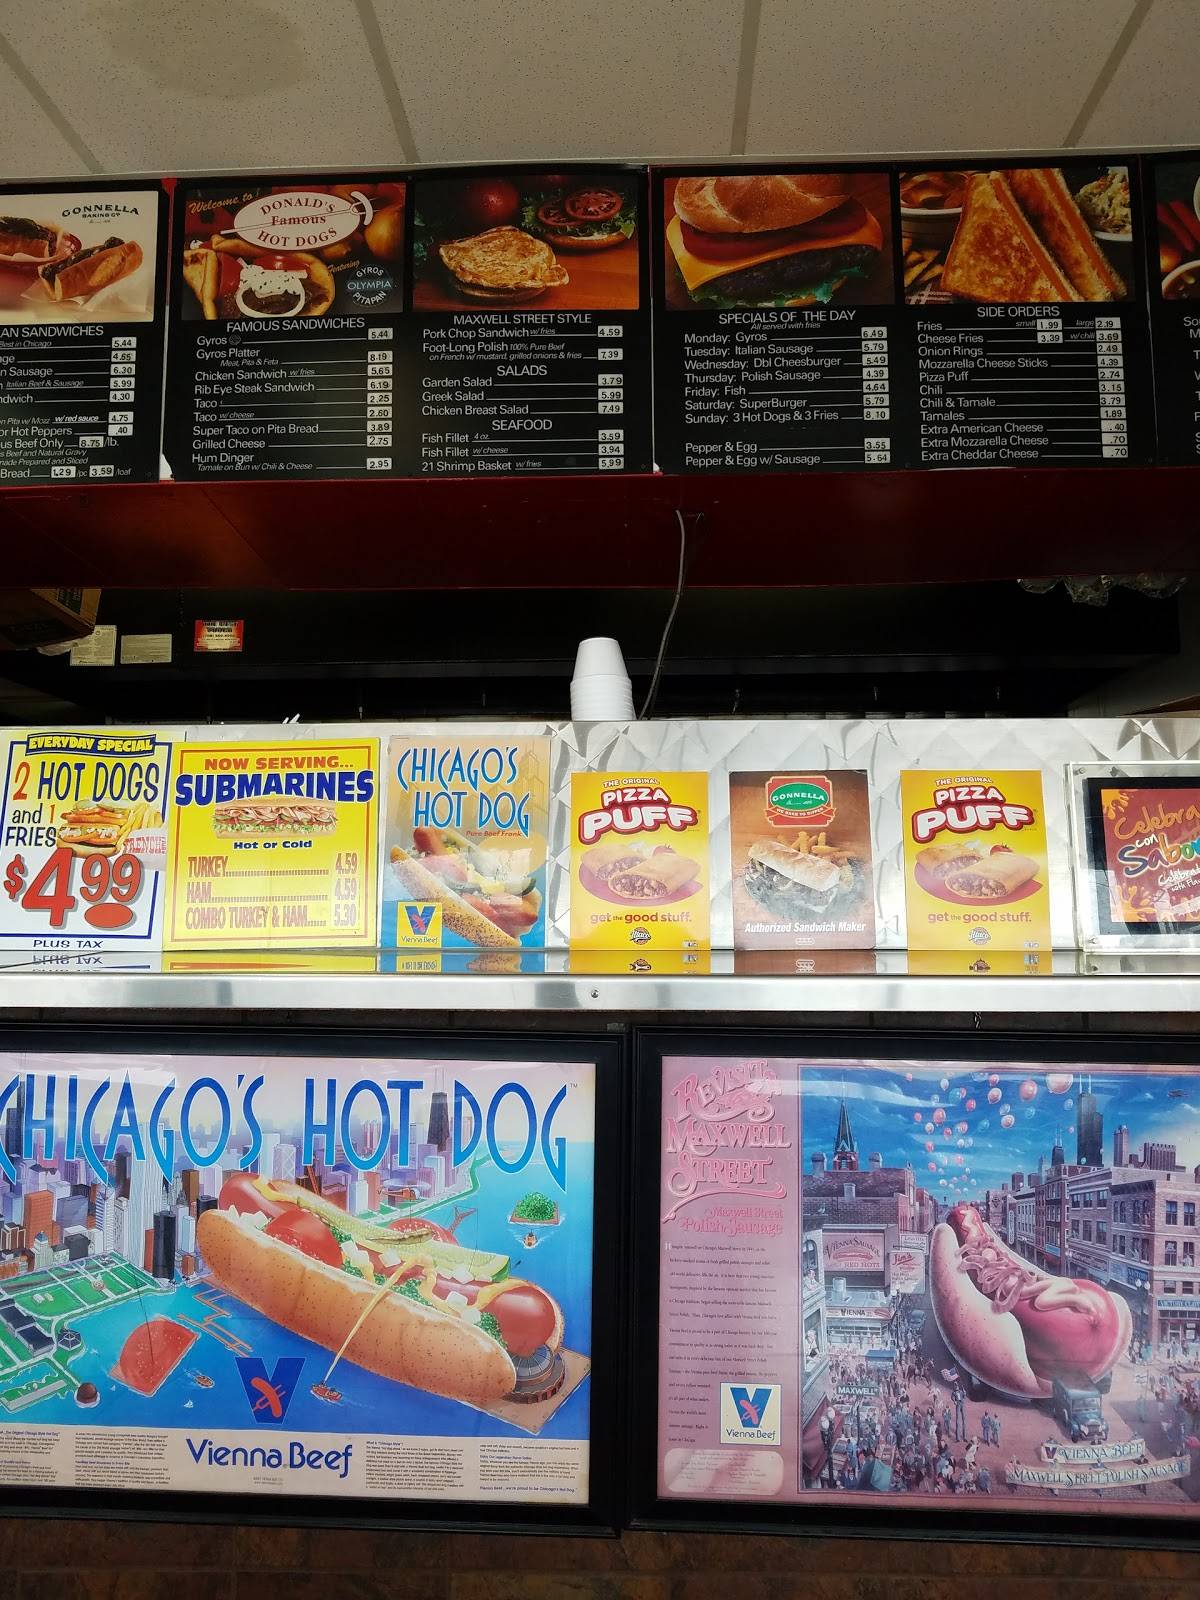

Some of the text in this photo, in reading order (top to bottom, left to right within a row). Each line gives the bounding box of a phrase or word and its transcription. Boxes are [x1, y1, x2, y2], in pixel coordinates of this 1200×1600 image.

[62, 204, 139, 218] GONNELLA
[260, 197, 335, 215] DONALD'S
[271, 215, 326, 225] Famous
[257, 227, 337, 246] HOT DOGS
[356, 266, 384, 277] GYROS
[347, 281, 391, 290] OLYMPIA
[719, 310, 855, 324] SPECIALS OF THE DAY
[977, 306, 1060, 317] SIDE ORDERS
[227, 318, 365, 332] FAMOUS SANDWICHES
[454, 314, 591, 324] MAXWELL STREET STYLE
[22, 326, 103, 337] SANDWICHES
[423, 329, 446, 338] Pork
[448, 328, 476, 339] Chop
[478, 327, 529, 337] Sandwich
[197, 335, 227, 347] Gyros
[684, 332, 767, 344] Monday: Gyros
[919, 346, 983, 357] Onion Rings
[684, 359, 748, 370] Wednesday:
[754, 358, 771, 367] Dbl
[774, 357, 841, 369] Cheesburger
[919, 359, 974, 368] Mozzarella
[977, 359, 1015, 368] Cheese
[1018, 358, 1048, 368] Sticks
[9, 367, 53, 377] Sausage
[195, 371, 234, 382] Chicken
[237, 370, 286, 380] Sandwich
[497, 365, 547, 376] SALADS
[920, 372, 968, 382] Pizza Puff
[194, 383, 314, 395] Rib Eye Steak Sandwich
[422, 405, 462, 416] Chicken
[465, 405, 497, 415] Breast
[500, 405, 528, 414] Salad
[685, 399, 807, 410] Saturday: SuperBurger
[920, 410, 1122, 421] Tamales 1.89
[492, 420, 552, 430] SEAFOOD
[11, 427, 72, 437] Hot Peppers
[15, 438, 63, 449] Beef Only
[193, 437, 388, 449] Grilled Cheese 2.75
[686, 443, 721, 454] Pepper
[725, 442, 733, 451] &
[736, 442, 757, 453] Egg
[192, 454, 254, 465] Hum Dinger
[922, 449, 1039, 461] Extra Cheddar Cheese
[437, 461, 511, 472] Shrimp Basket
[1, 469, 30, 478] Bread
[28, 735, 152, 751] EVERYDAY SPECIAL
[205, 758, 249, 770] NOW
[397, 745, 518, 791] CHICAGO'S
[13, 761, 159, 801] 2 HOT DOGS
[603, 779, 619, 788] THE
[175, 770, 374, 805] SUBMARINES
[603, 788, 668, 806] PIZZA
[772, 793, 825, 802] GONNELLA
[936, 788, 1003, 805] PIZZA
[12, 803, 55, 824] and 1
[414, 791, 530, 837] HOT DOG
[583, 806, 693, 840] PUFF
[917, 806, 1029, 839] PUFF
[5, 827, 56, 846] FRIES
[1135, 834, 1158, 848] con
[234, 841, 258, 849] Hot
[283, 840, 312, 848] Cold
[336, 853, 357, 875] 4.59
[335, 878, 356, 900] 4.59
[186, 907, 226, 930] COMBO
[229, 906, 269, 928] TURKEY
[272, 906, 280, 927] &
[591, 913, 612, 923] get
[625, 912, 658, 923] good
[660, 912, 692, 922] stuff.
[928, 912, 949, 923] get
[963, 912, 997, 922] good
[1000, 912, 1031, 922] stuff.
[745, 922, 866, 933] Authorized Sandwich Maker
[33, 940, 103, 948] PLUS TAX
[301, 1078, 567, 1193] HOT DOG
[726, 1429, 776, 1440] Vienna Beef
[186, 1439, 282, 1468] Vienna
[289, 1442, 352, 1478] Beef
[1060, 1449, 1107, 1460] VIENNA
